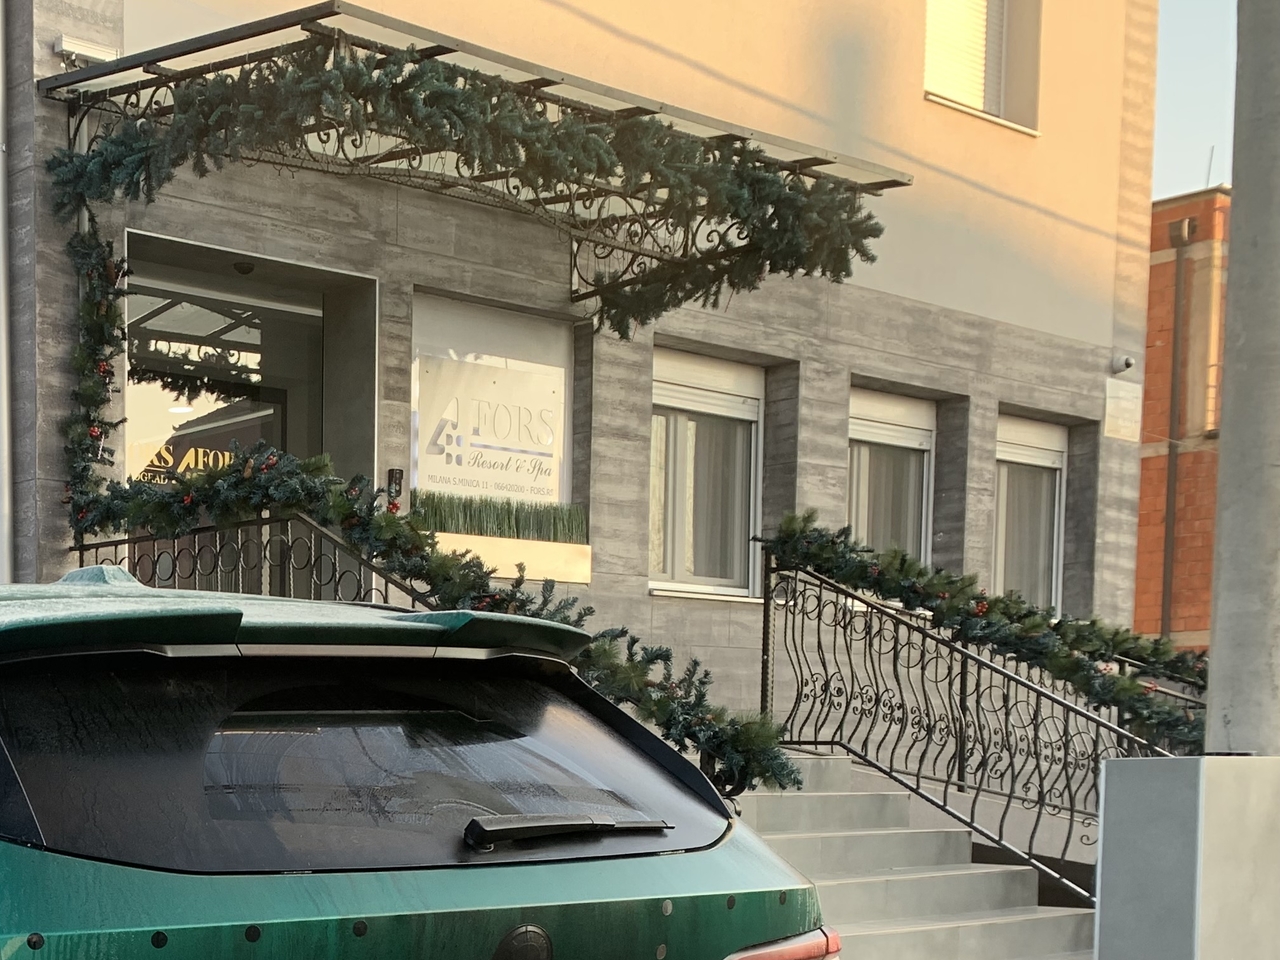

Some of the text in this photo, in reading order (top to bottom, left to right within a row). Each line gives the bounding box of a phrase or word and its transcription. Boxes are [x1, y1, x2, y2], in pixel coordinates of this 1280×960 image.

[467, 450, 512, 472] Resort
[527, 457, 553, 482] Spa
[427, 474, 452, 486] MILANA
[481, 479, 489, 490] 11
